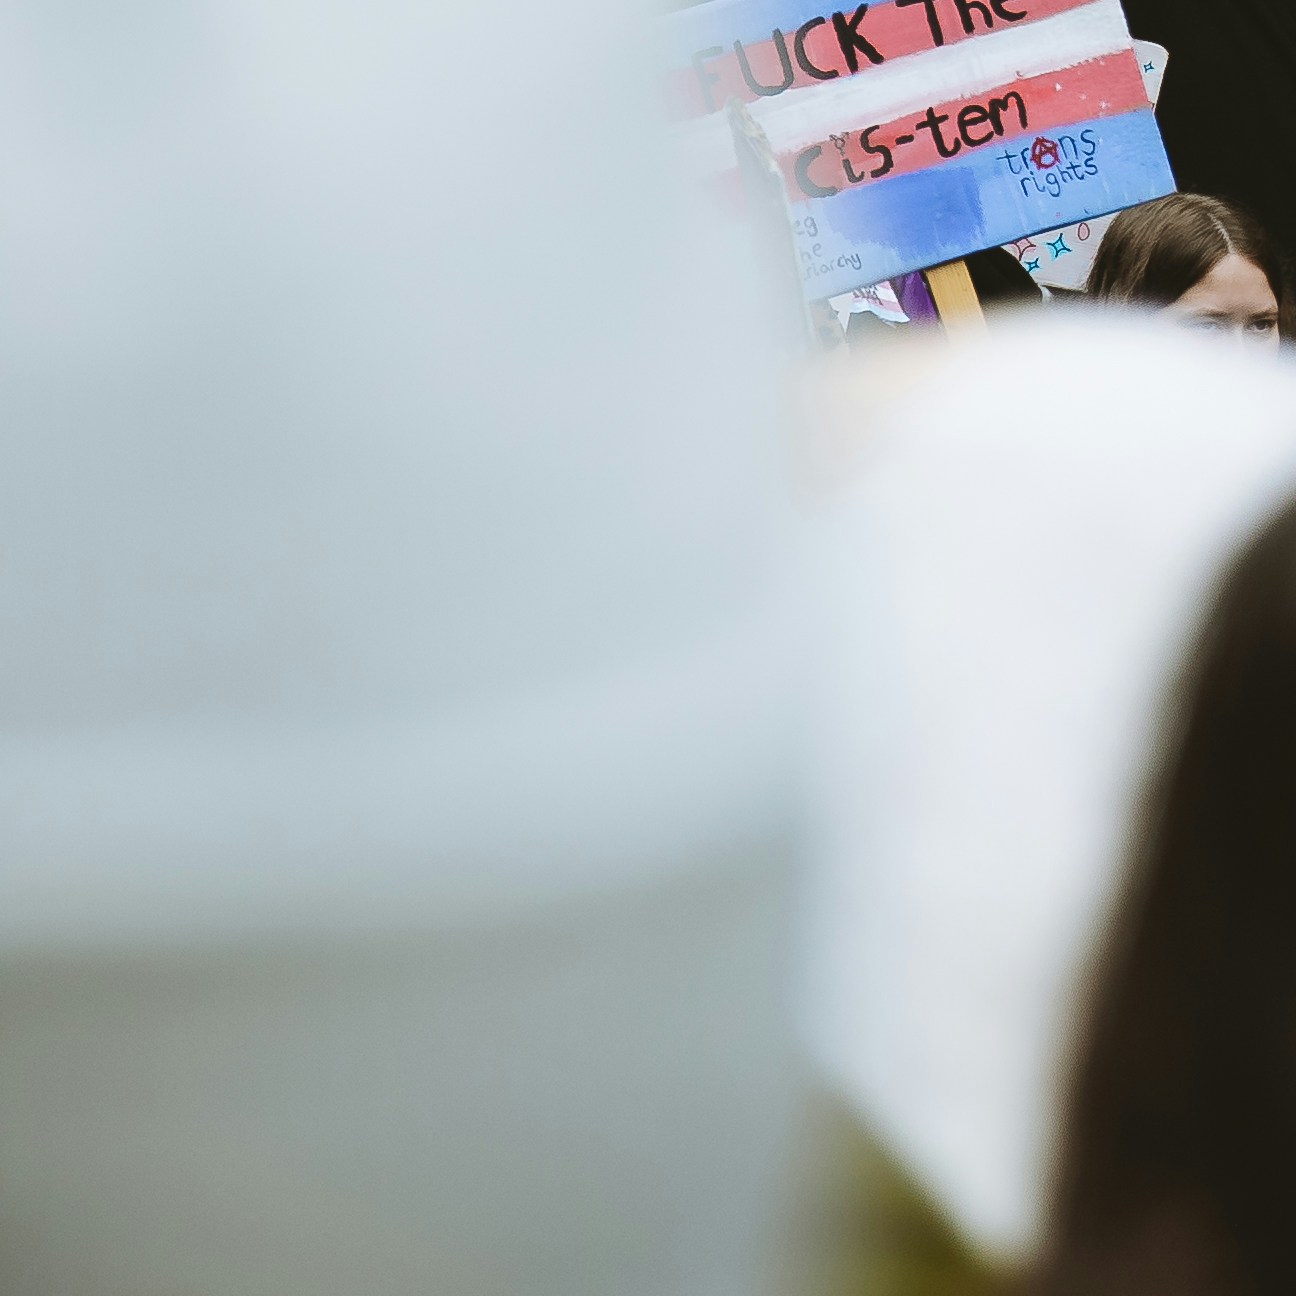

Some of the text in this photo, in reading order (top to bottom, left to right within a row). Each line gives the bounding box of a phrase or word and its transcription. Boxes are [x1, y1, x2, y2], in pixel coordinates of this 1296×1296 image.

[690, 3, 885, 113] FUCK
[1020, 157, 1098, 197] rights
[793, 216, 819, 238] eg
